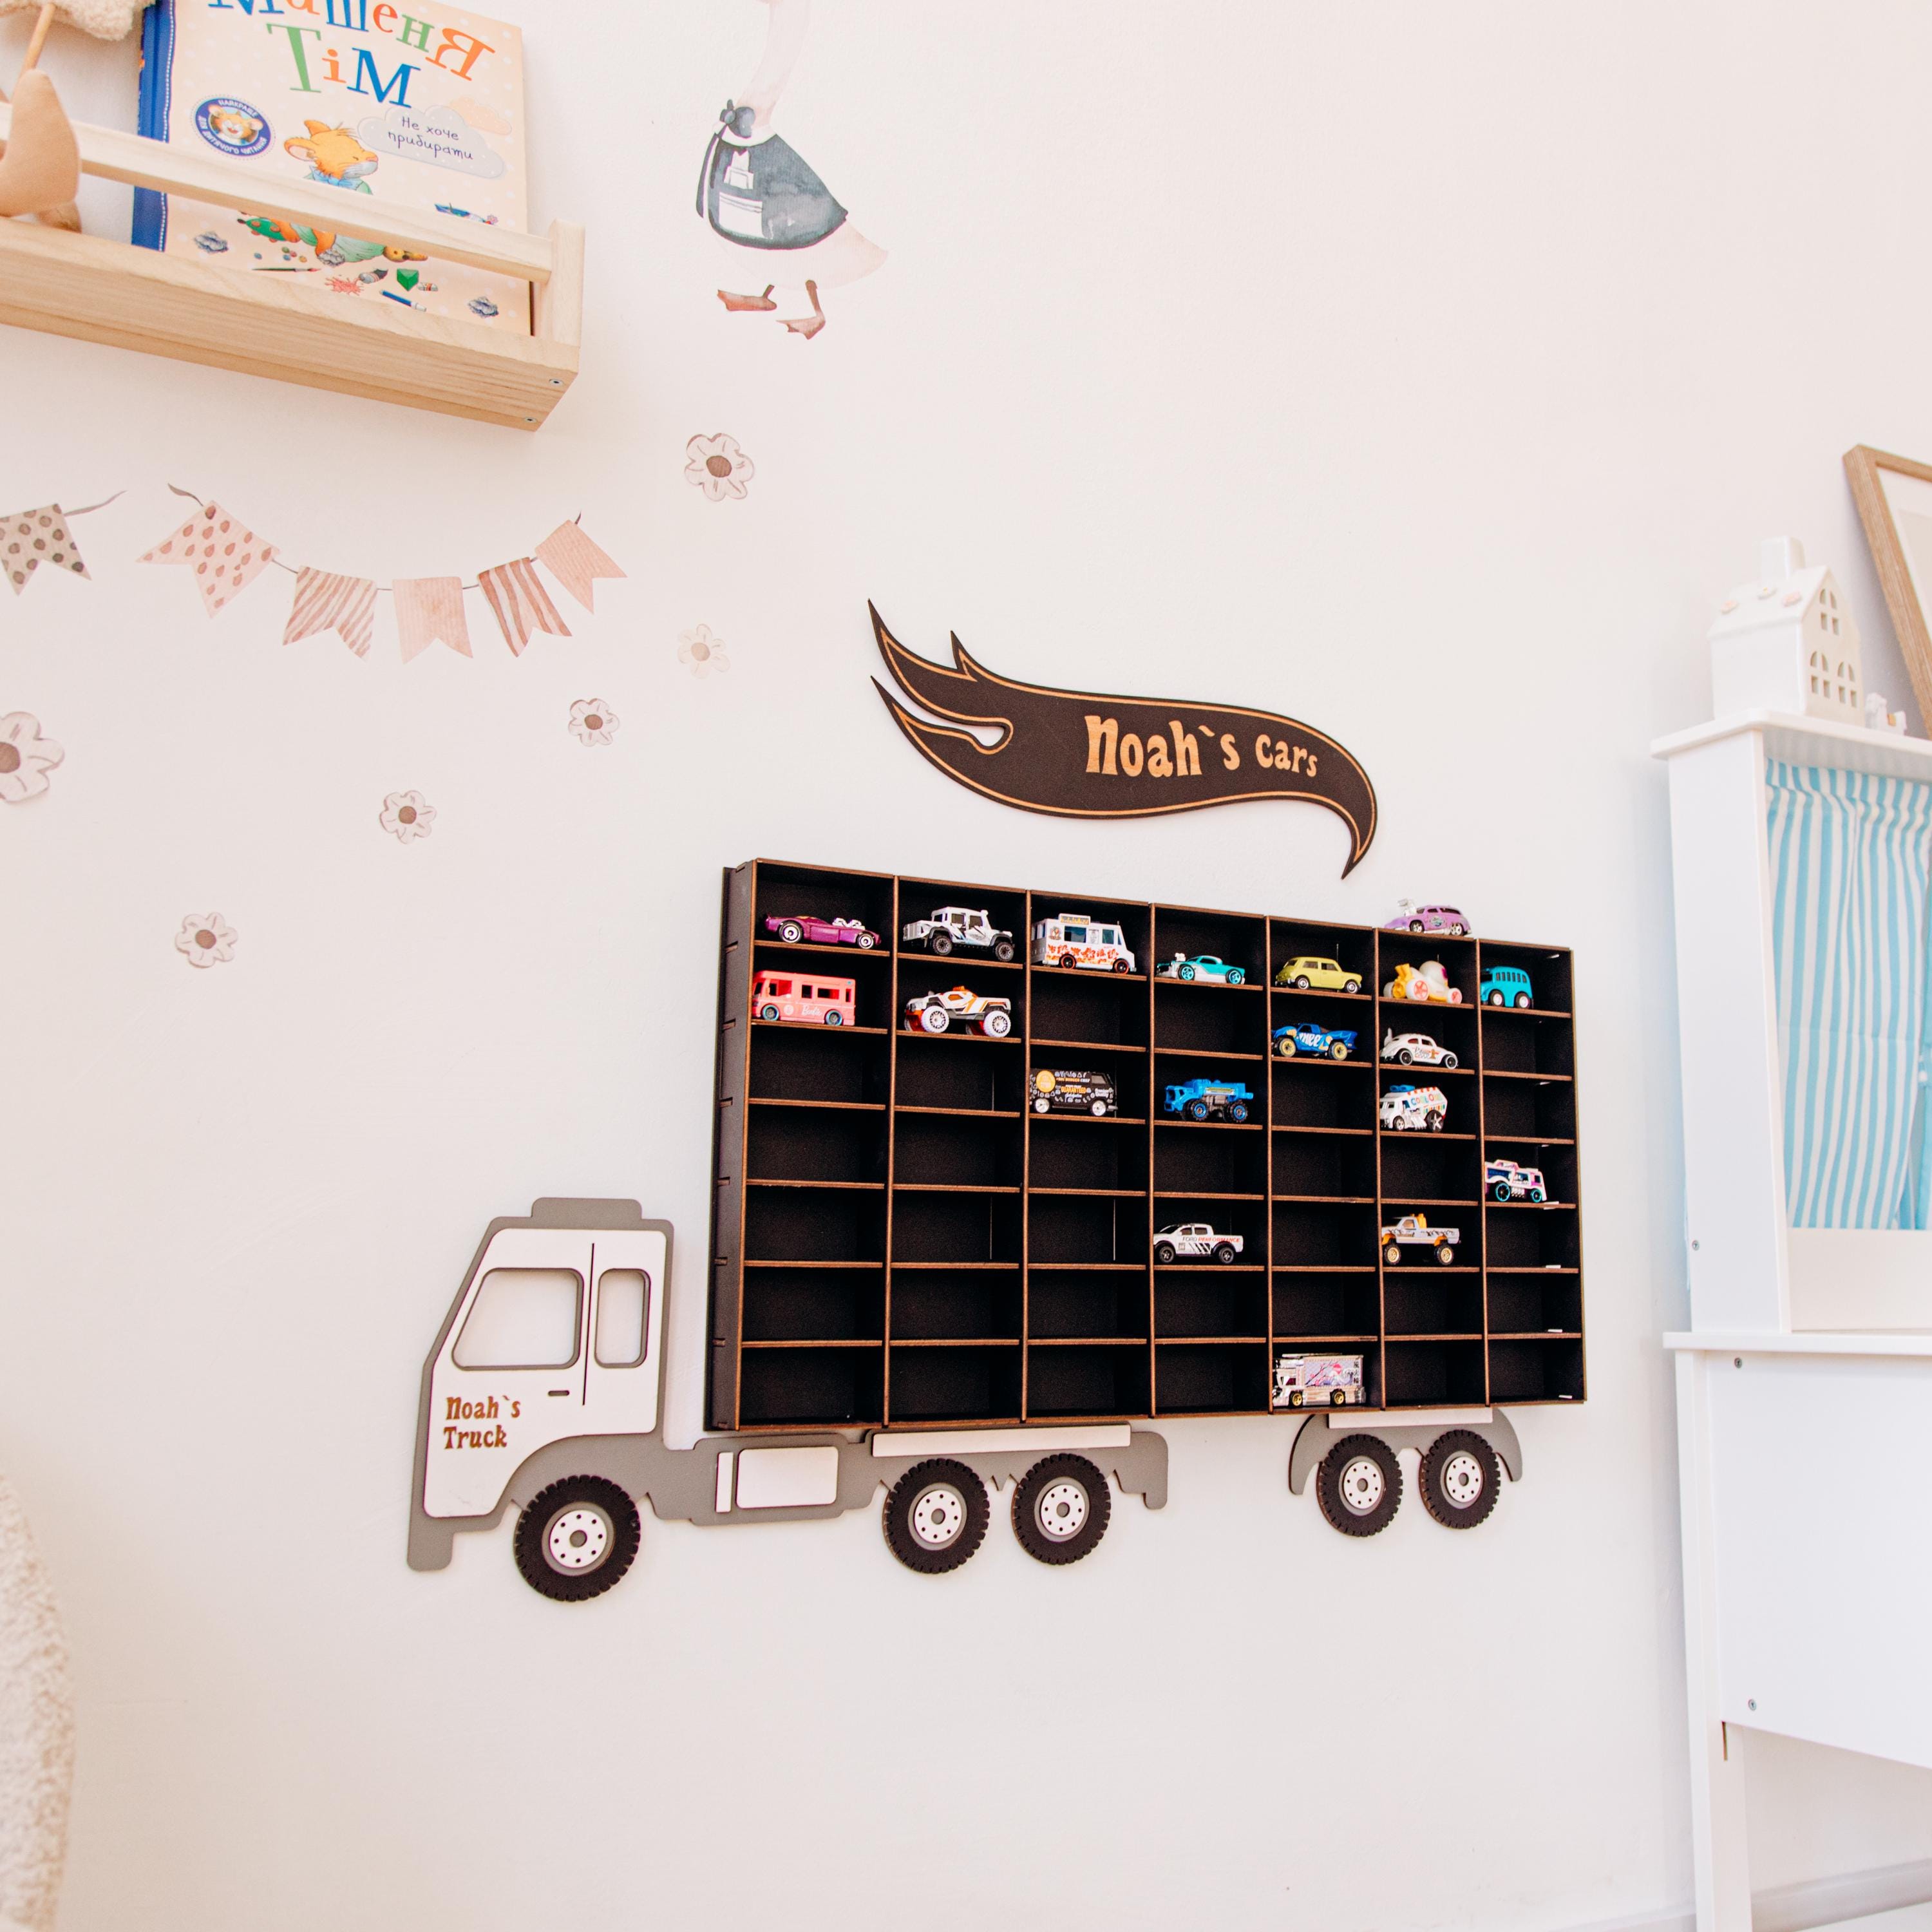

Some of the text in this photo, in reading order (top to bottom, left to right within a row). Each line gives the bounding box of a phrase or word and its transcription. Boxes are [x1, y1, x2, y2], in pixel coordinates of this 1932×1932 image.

[401, 116, 459, 141] Не хоче
[388, 131, 473, 160] прибирати
[443, 1424, 507, 1450] Truck
